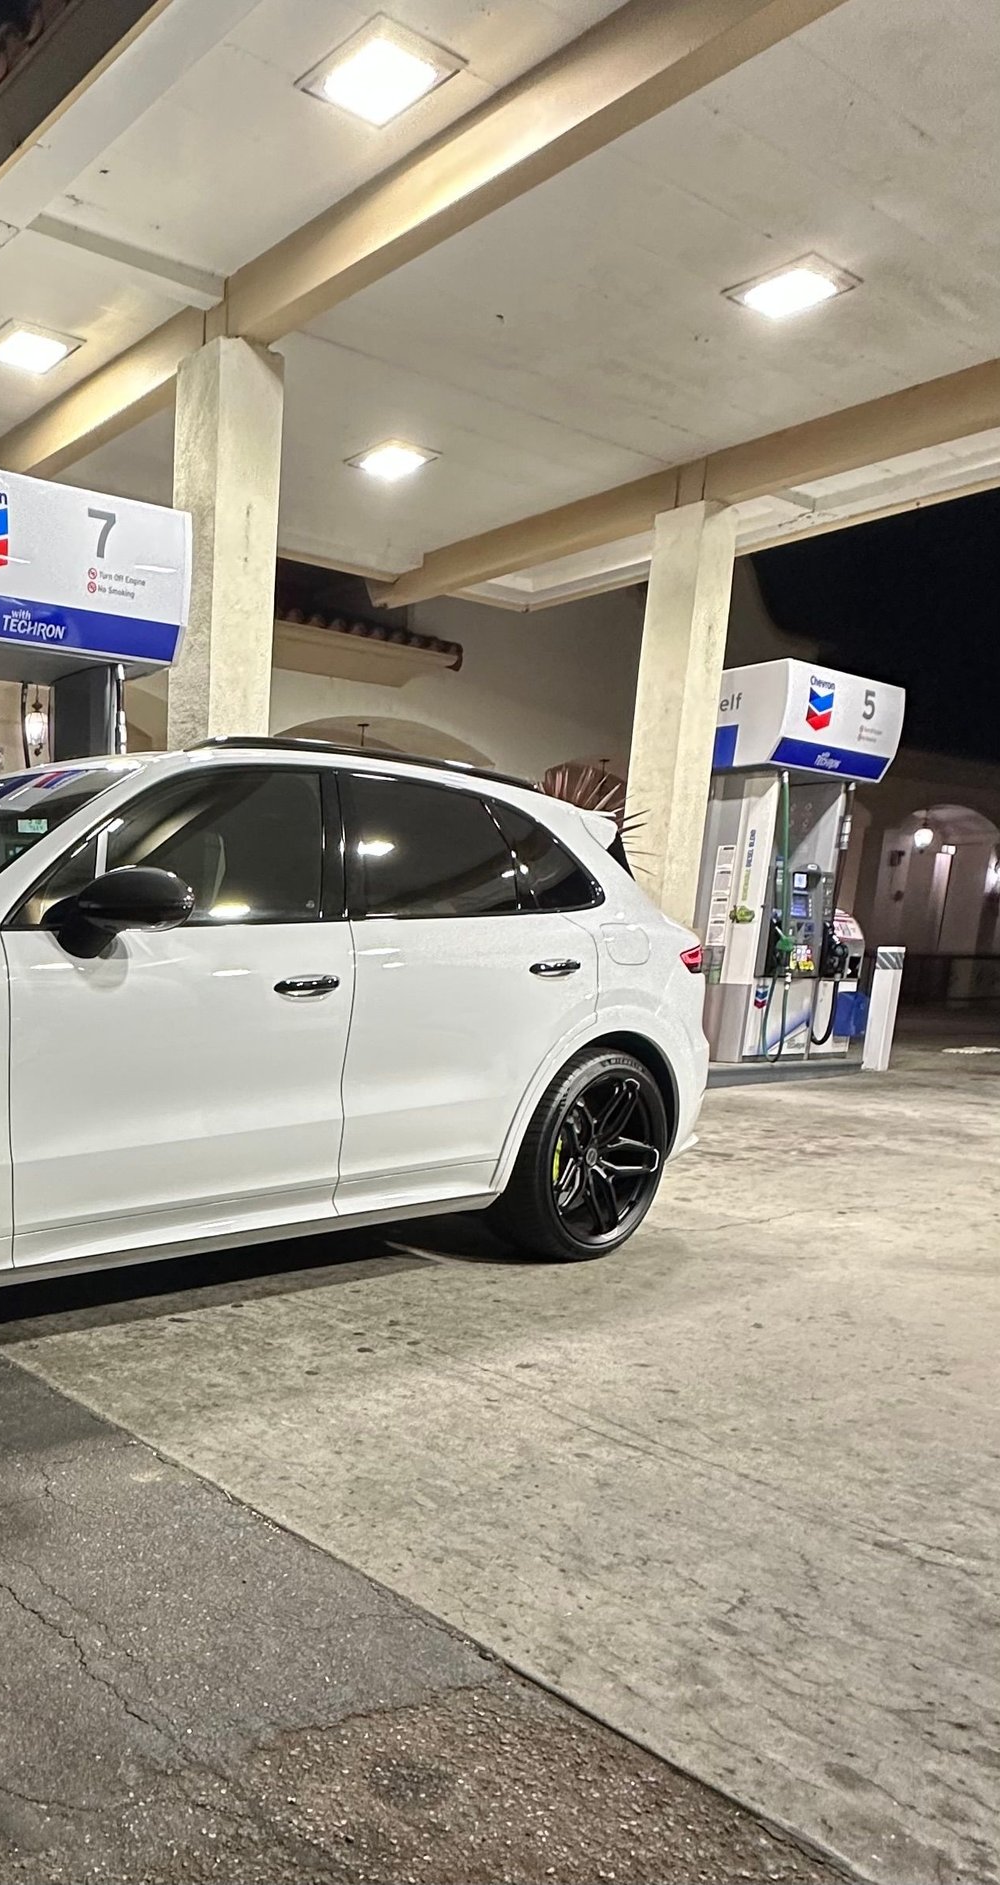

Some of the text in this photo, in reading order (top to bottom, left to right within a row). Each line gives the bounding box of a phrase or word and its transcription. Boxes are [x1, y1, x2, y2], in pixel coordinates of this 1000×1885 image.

[87, 507, 117, 559] 7
[99, 570, 146, 587] Turn Off Engine
[97, 584, 136, 600] No Smoking
[11, 609, 31, 621] with
[2, 614, 66, 641] TECHRON
[810, 675, 836, 691] Chevron
[720, 692, 743, 712] elf
[862, 689, 876, 721] 5
